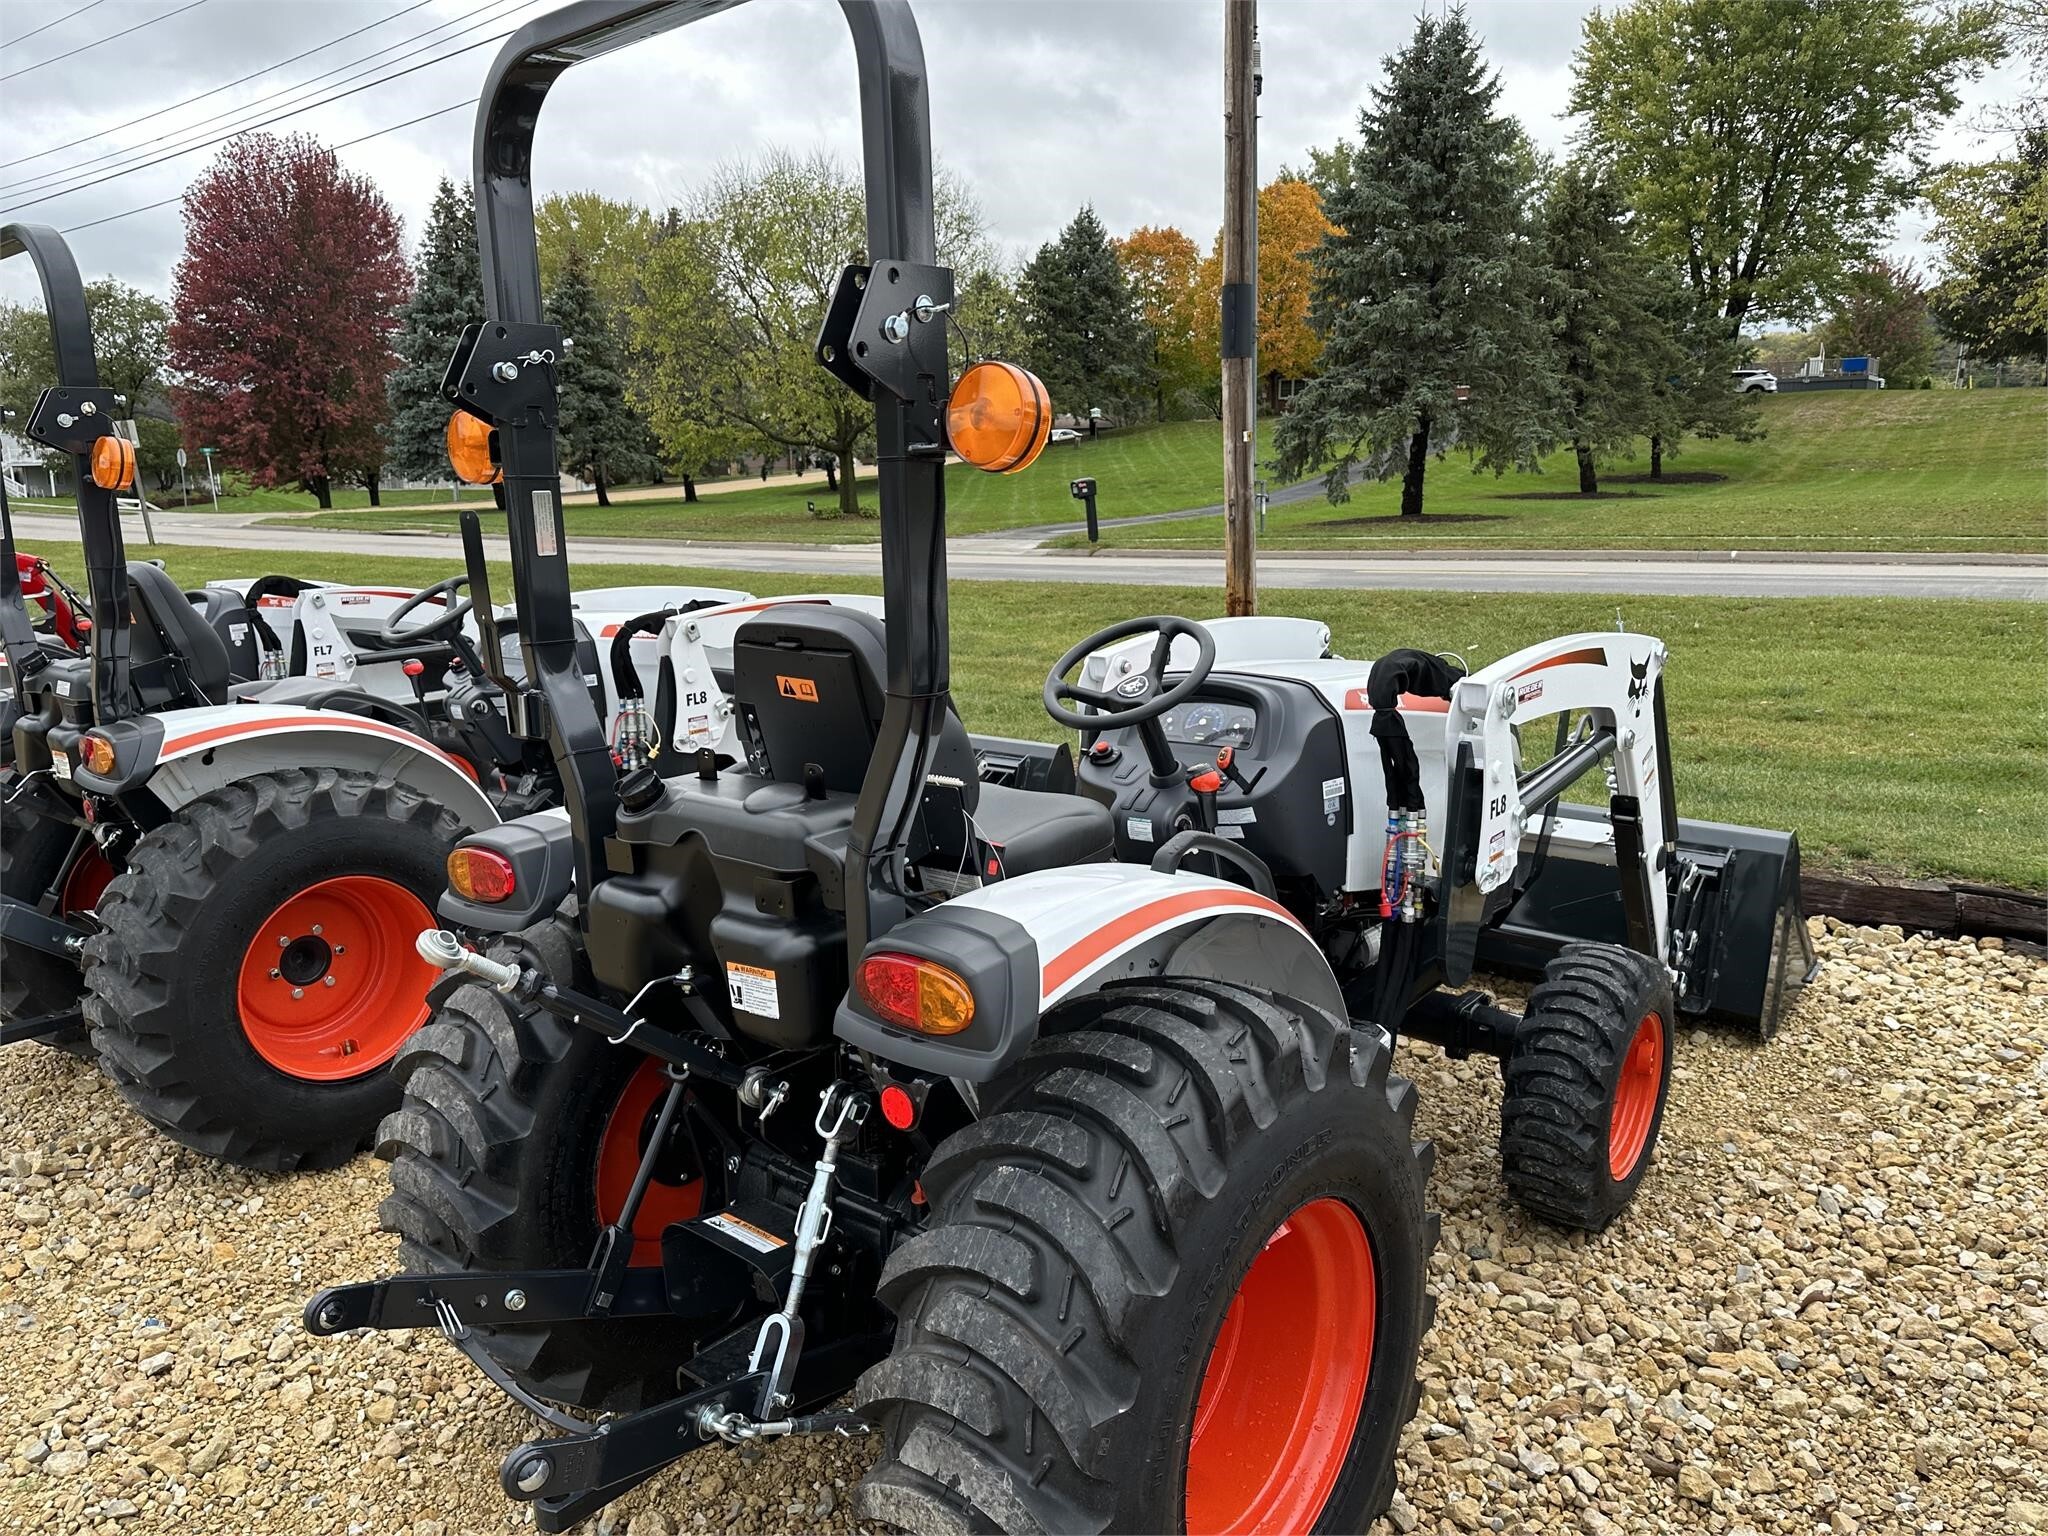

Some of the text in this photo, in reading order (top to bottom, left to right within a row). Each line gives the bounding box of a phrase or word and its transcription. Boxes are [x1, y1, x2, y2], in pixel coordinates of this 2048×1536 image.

[314, 645, 332, 656] FL7
[686, 691, 707, 707] FL8
[1490, 794, 1507, 820] FL8
[740, 966, 767, 977] WARNING
